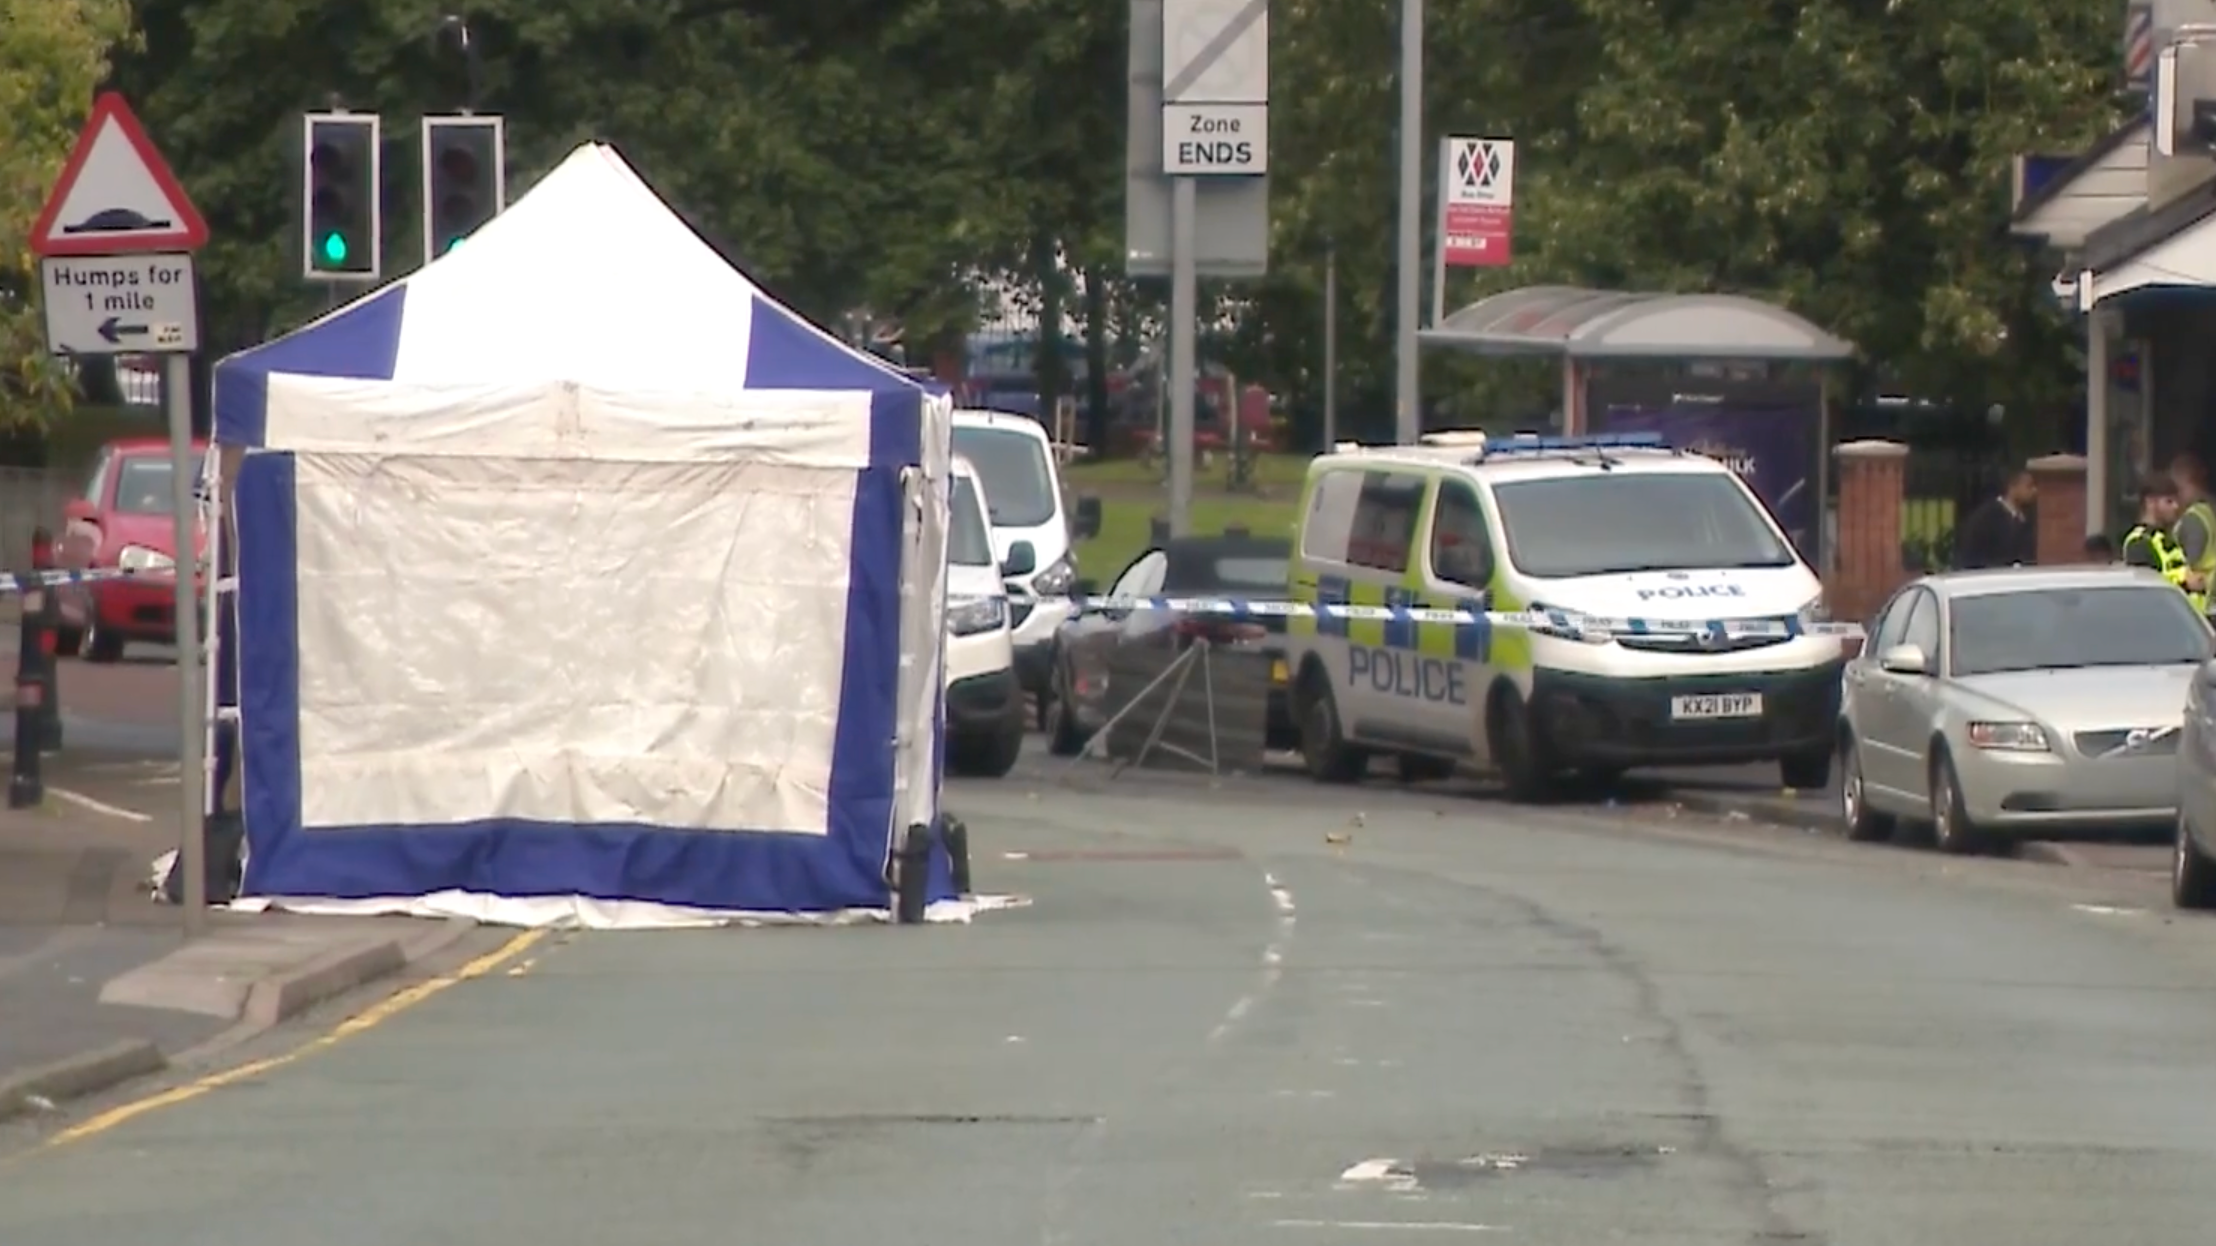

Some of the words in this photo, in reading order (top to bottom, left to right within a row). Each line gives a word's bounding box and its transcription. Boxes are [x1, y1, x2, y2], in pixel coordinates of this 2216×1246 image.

[1190, 115, 1241, 133] Zone
[1178, 142, 1252, 165] ENDS
[54, 266, 140, 288] Humps
[149, 264, 183, 284] for
[85, 292, 94, 311] 1
[104, 291, 155, 310] mile
[1637, 584, 1746, 601] POLICE
[1348, 646, 1467, 705] POLICE
[1683, 700, 1719, 714] KX21
[1722, 698, 1752, 713] BYP
